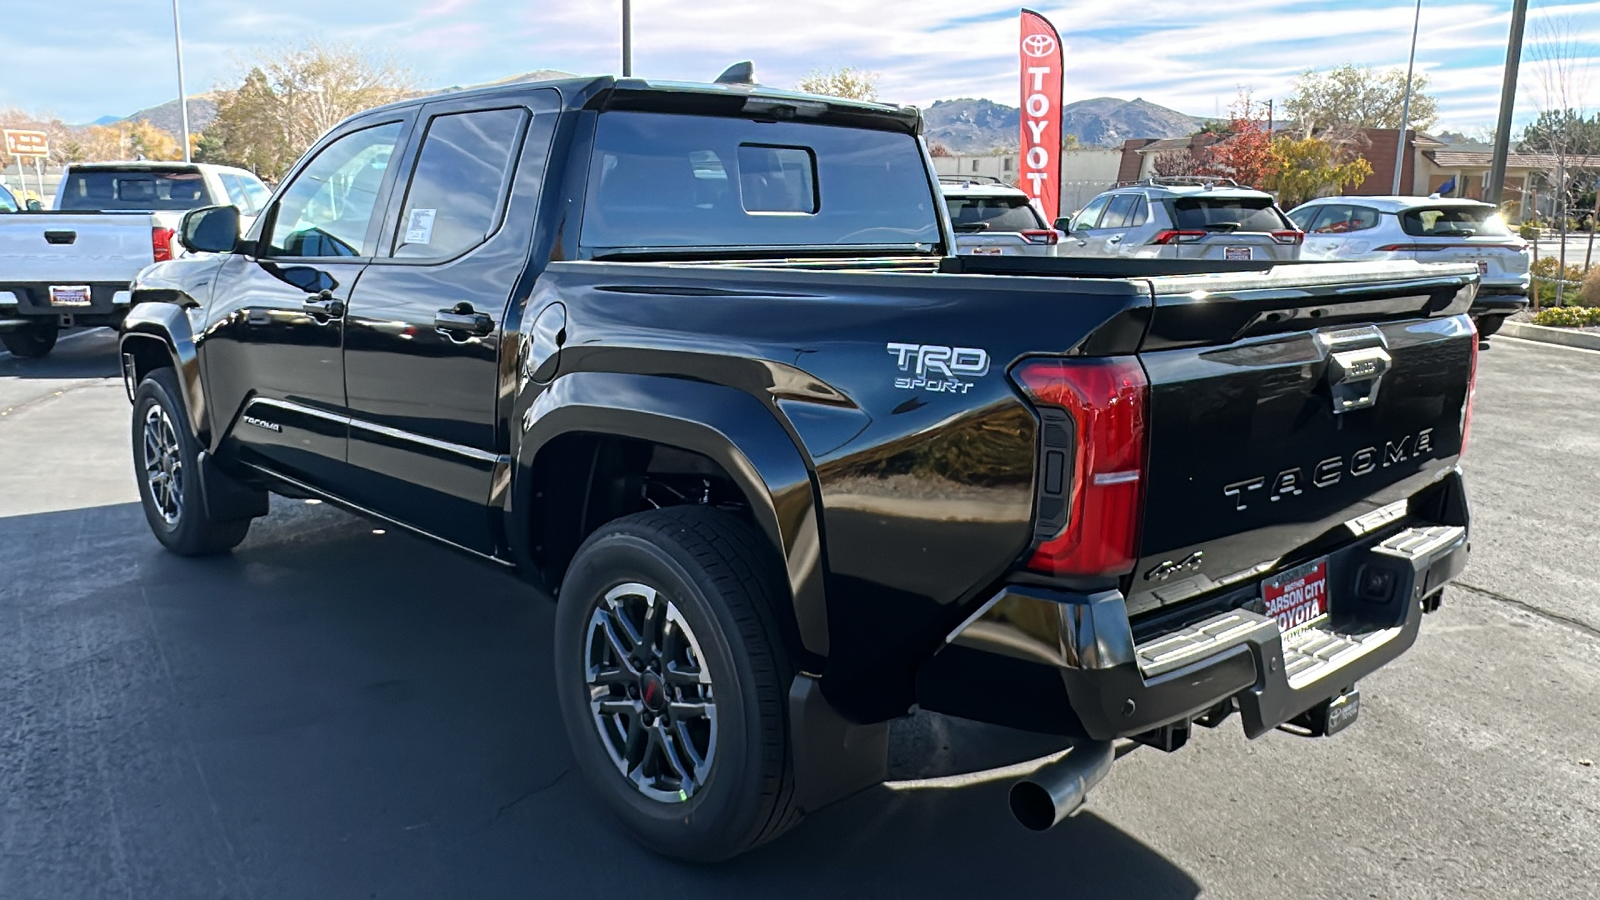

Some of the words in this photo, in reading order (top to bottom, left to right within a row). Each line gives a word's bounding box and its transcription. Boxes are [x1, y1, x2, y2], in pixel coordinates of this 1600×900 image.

[887, 342, 991, 378] TRD
[894, 377, 974, 394] SPORT
[243, 415, 279, 431] TACOMA
[1224, 428, 1433, 511] TACOMA
[1304, 578, 1326, 599] CITY
